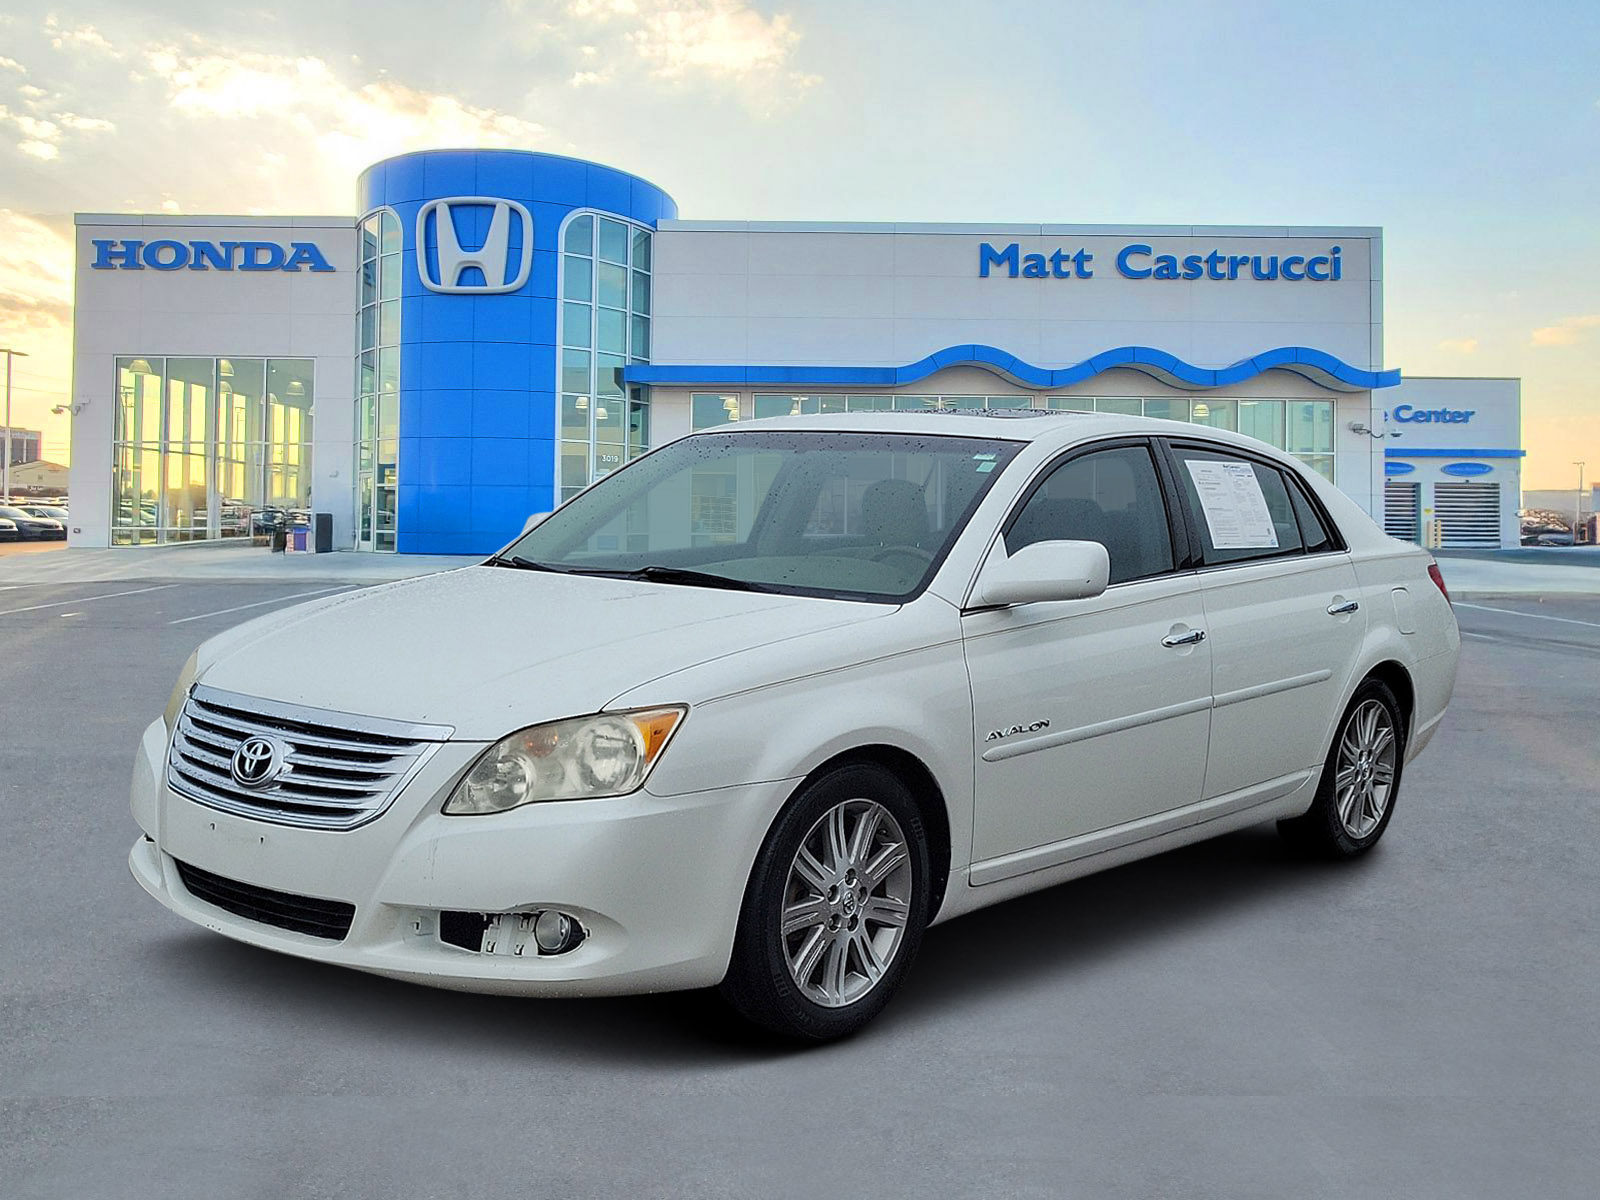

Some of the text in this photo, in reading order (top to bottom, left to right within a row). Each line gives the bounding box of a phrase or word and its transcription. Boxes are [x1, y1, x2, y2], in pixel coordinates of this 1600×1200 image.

[91, 240, 336, 272] HONDA
[979, 242, 1342, 281] Matt Castrucci
[1393, 404, 1476, 424] Center
[601, 454, 619, 463] 3019
[985, 719, 1050, 742] AVALON
